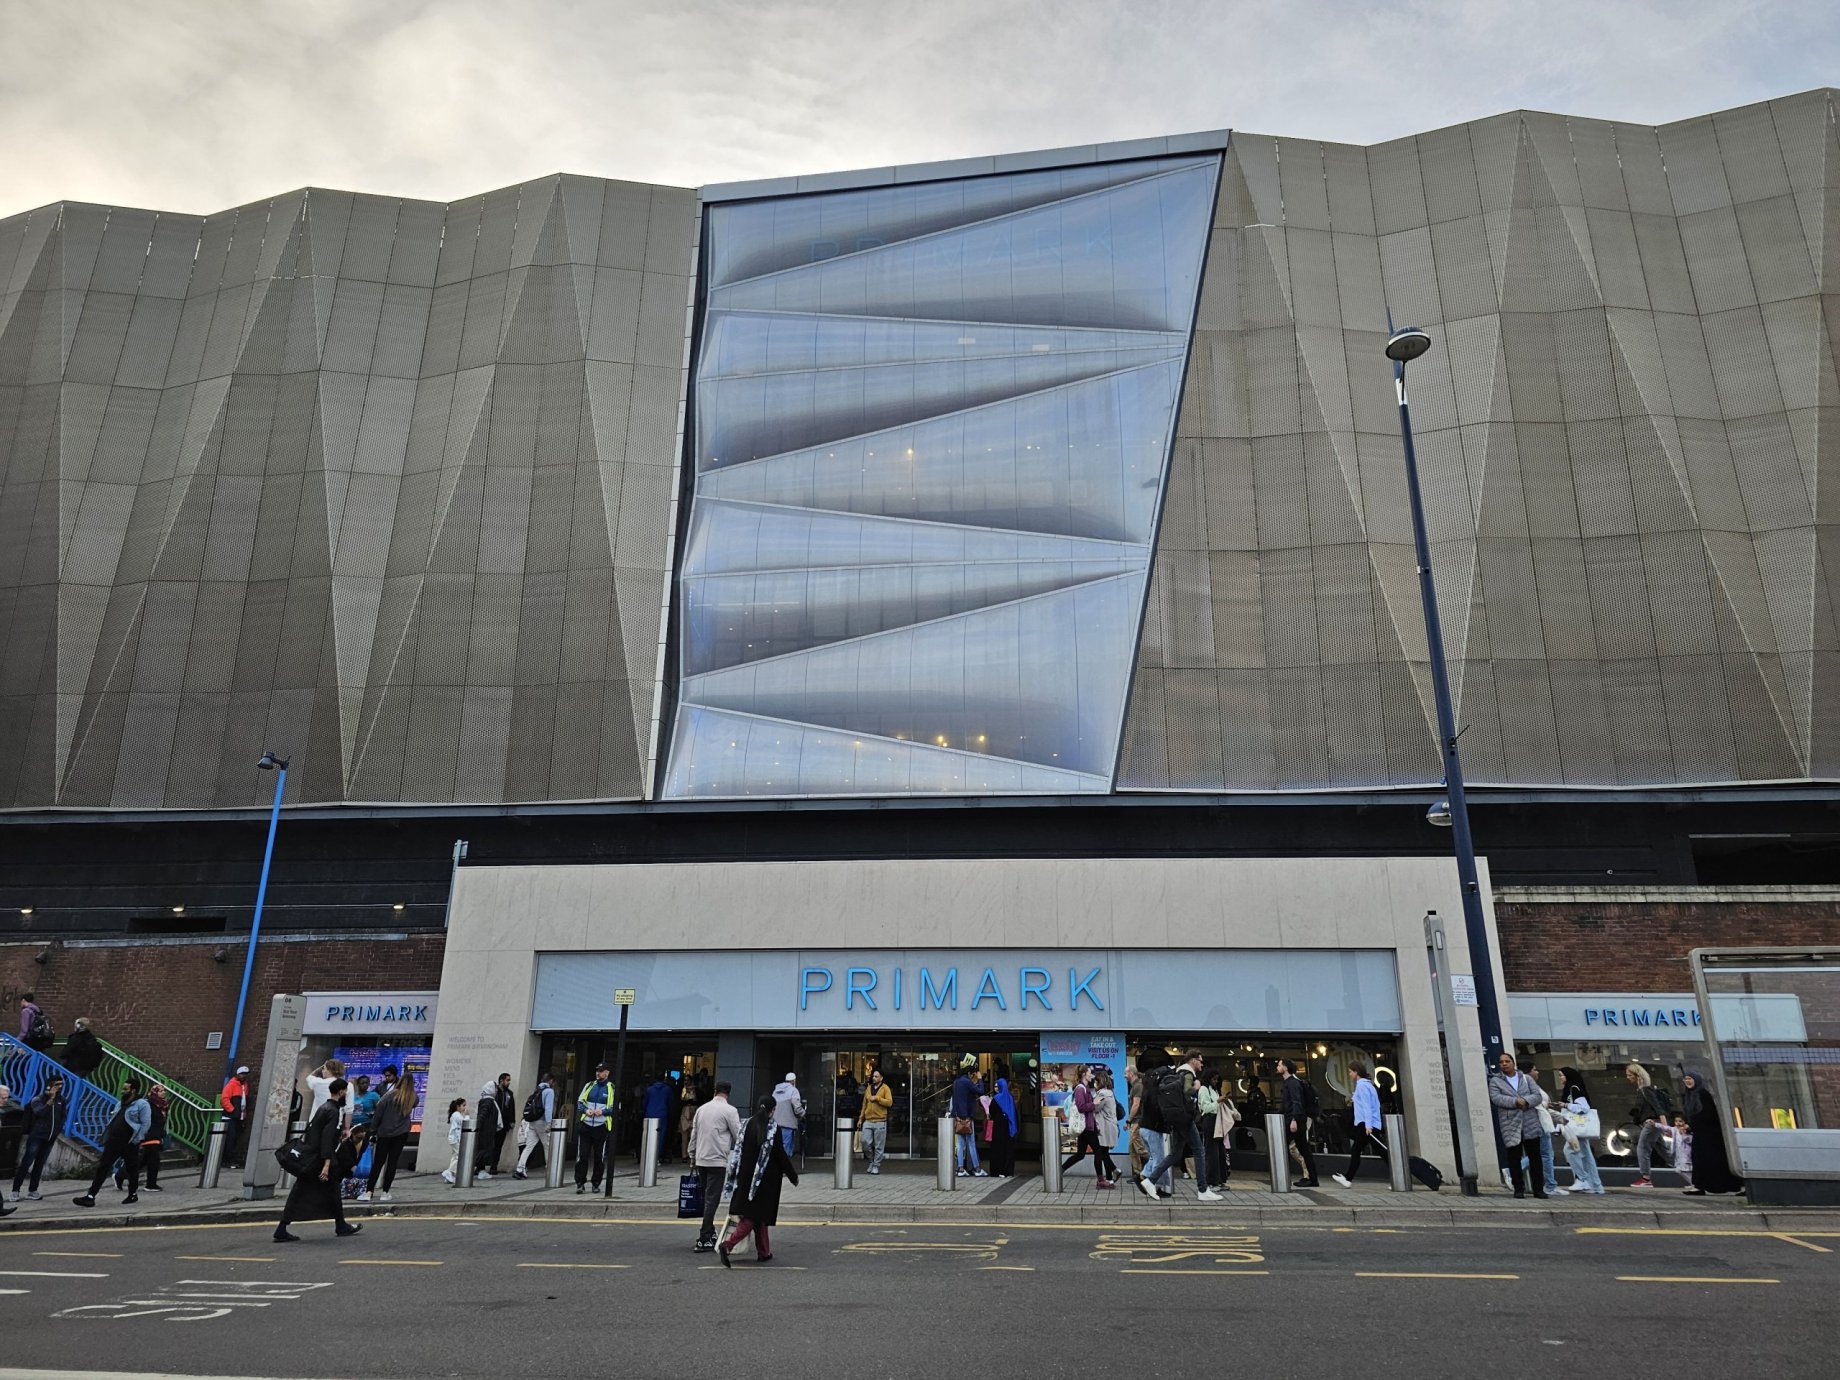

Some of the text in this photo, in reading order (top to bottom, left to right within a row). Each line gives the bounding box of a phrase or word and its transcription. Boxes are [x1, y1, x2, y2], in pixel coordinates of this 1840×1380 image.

[809, 222, 1113, 268] PRMARK
[801, 967, 1104, 1011] PRIMARK
[326, 1005, 428, 1022] PRIMARK
[1089, 1234, 1265, 1263] BUS
